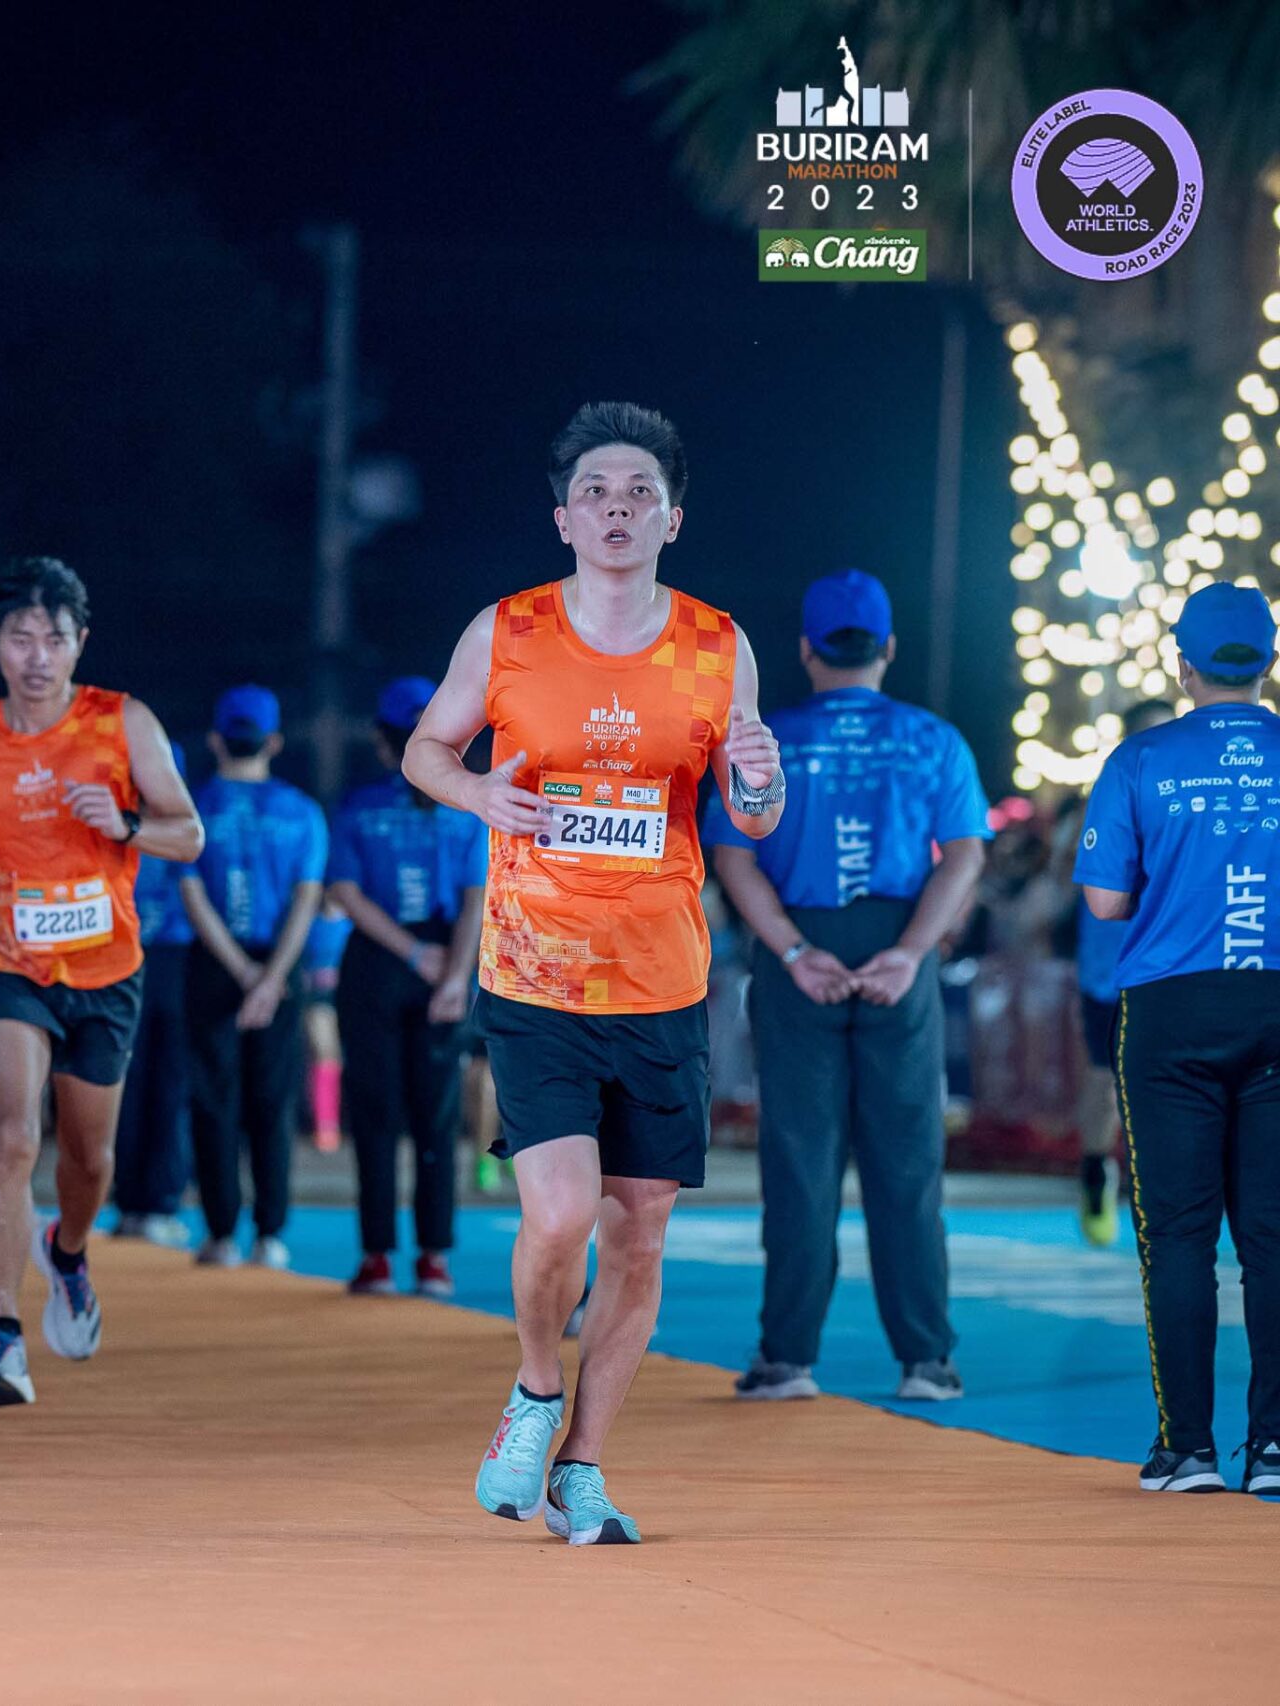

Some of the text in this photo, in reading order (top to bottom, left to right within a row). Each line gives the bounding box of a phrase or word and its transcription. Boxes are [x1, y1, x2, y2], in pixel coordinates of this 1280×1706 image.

[582, 721, 641, 737] BURIRAM
[600, 757, 634, 774] Chang
[1219, 752, 1264, 768] Chang
[1181, 777, 1234, 789] HONDA
[626, 789, 641, 798] M40
[560, 813, 647, 849] 23444
[34, 906, 98, 935] 22212
